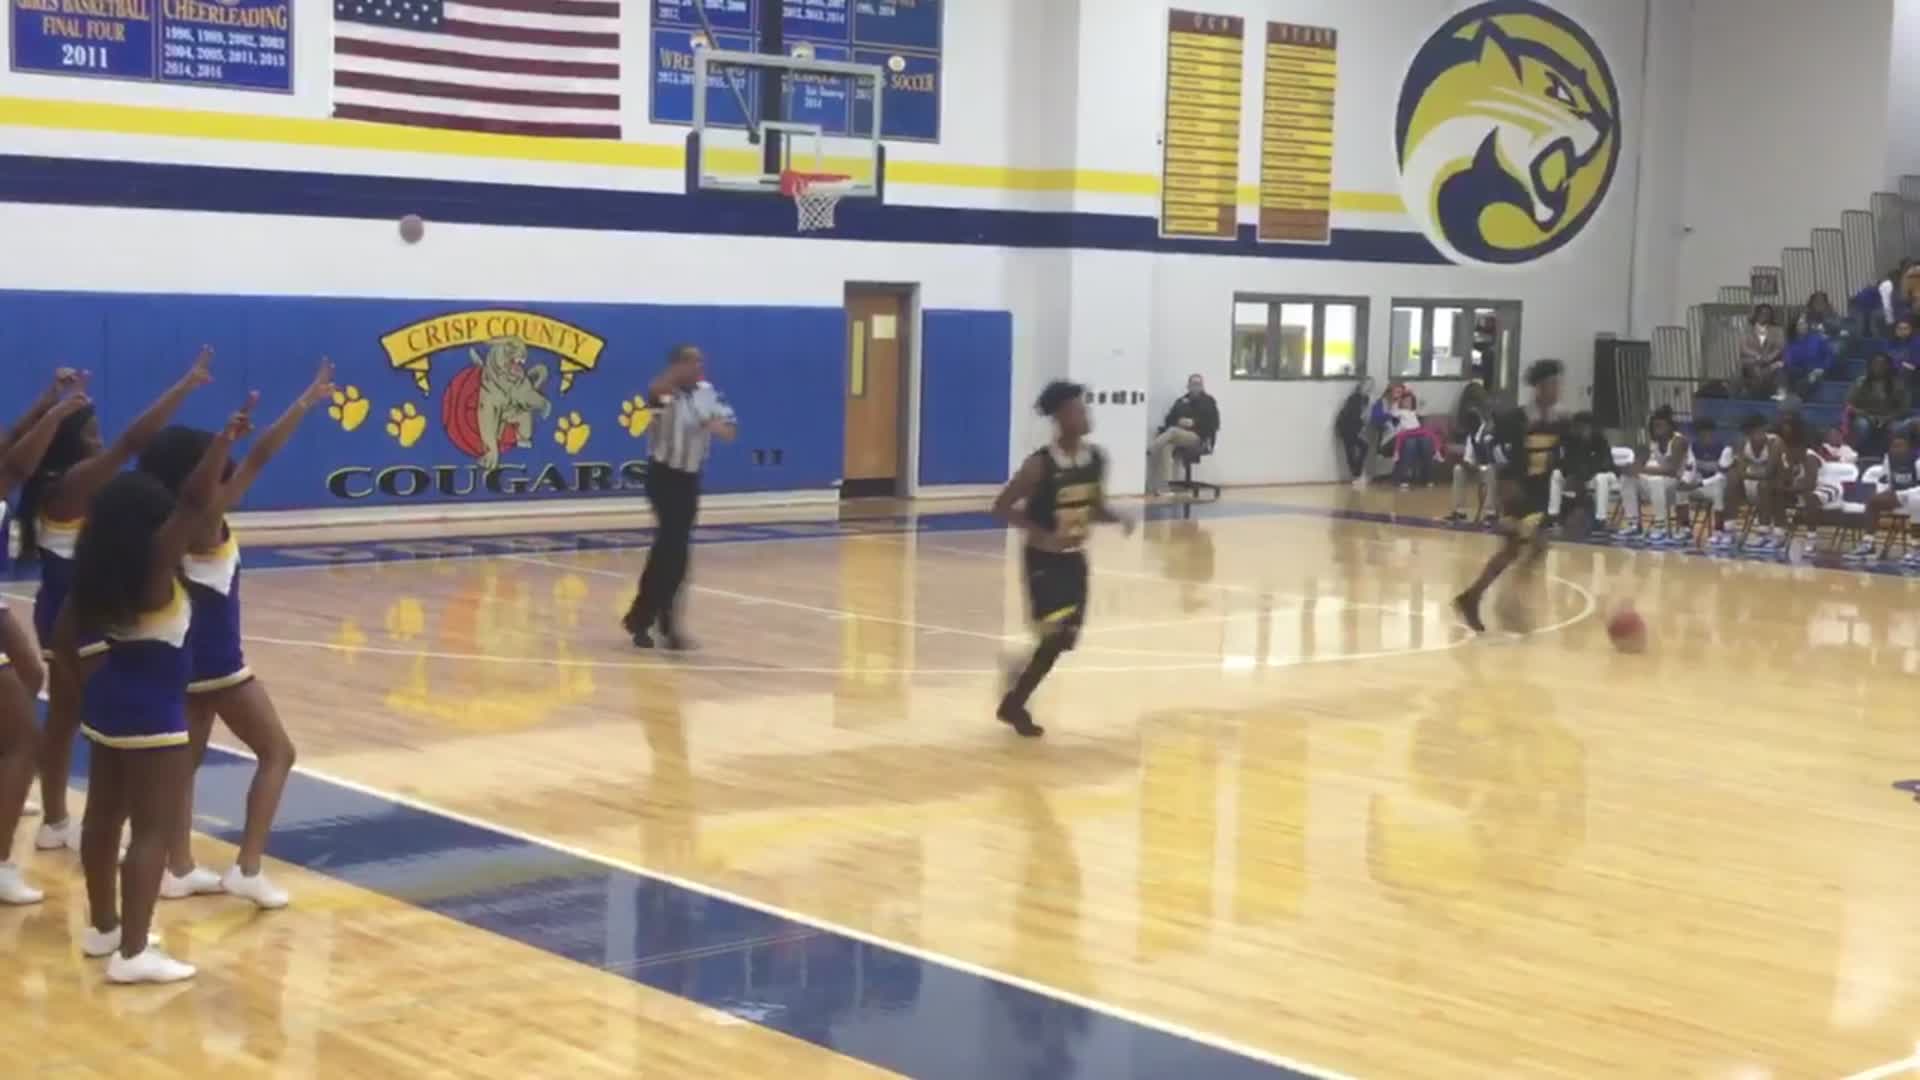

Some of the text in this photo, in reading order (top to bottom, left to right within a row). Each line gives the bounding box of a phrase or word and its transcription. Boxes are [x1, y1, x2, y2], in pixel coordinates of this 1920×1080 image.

[43, 15, 126, 42] FINAL FOUR
[163, 0, 287, 30] CHEERLEADING
[61, 43, 108, 69] 2011
[407, 314, 590, 356] CRISP COUNTY
[325, 459, 651, 500] COUGARS
